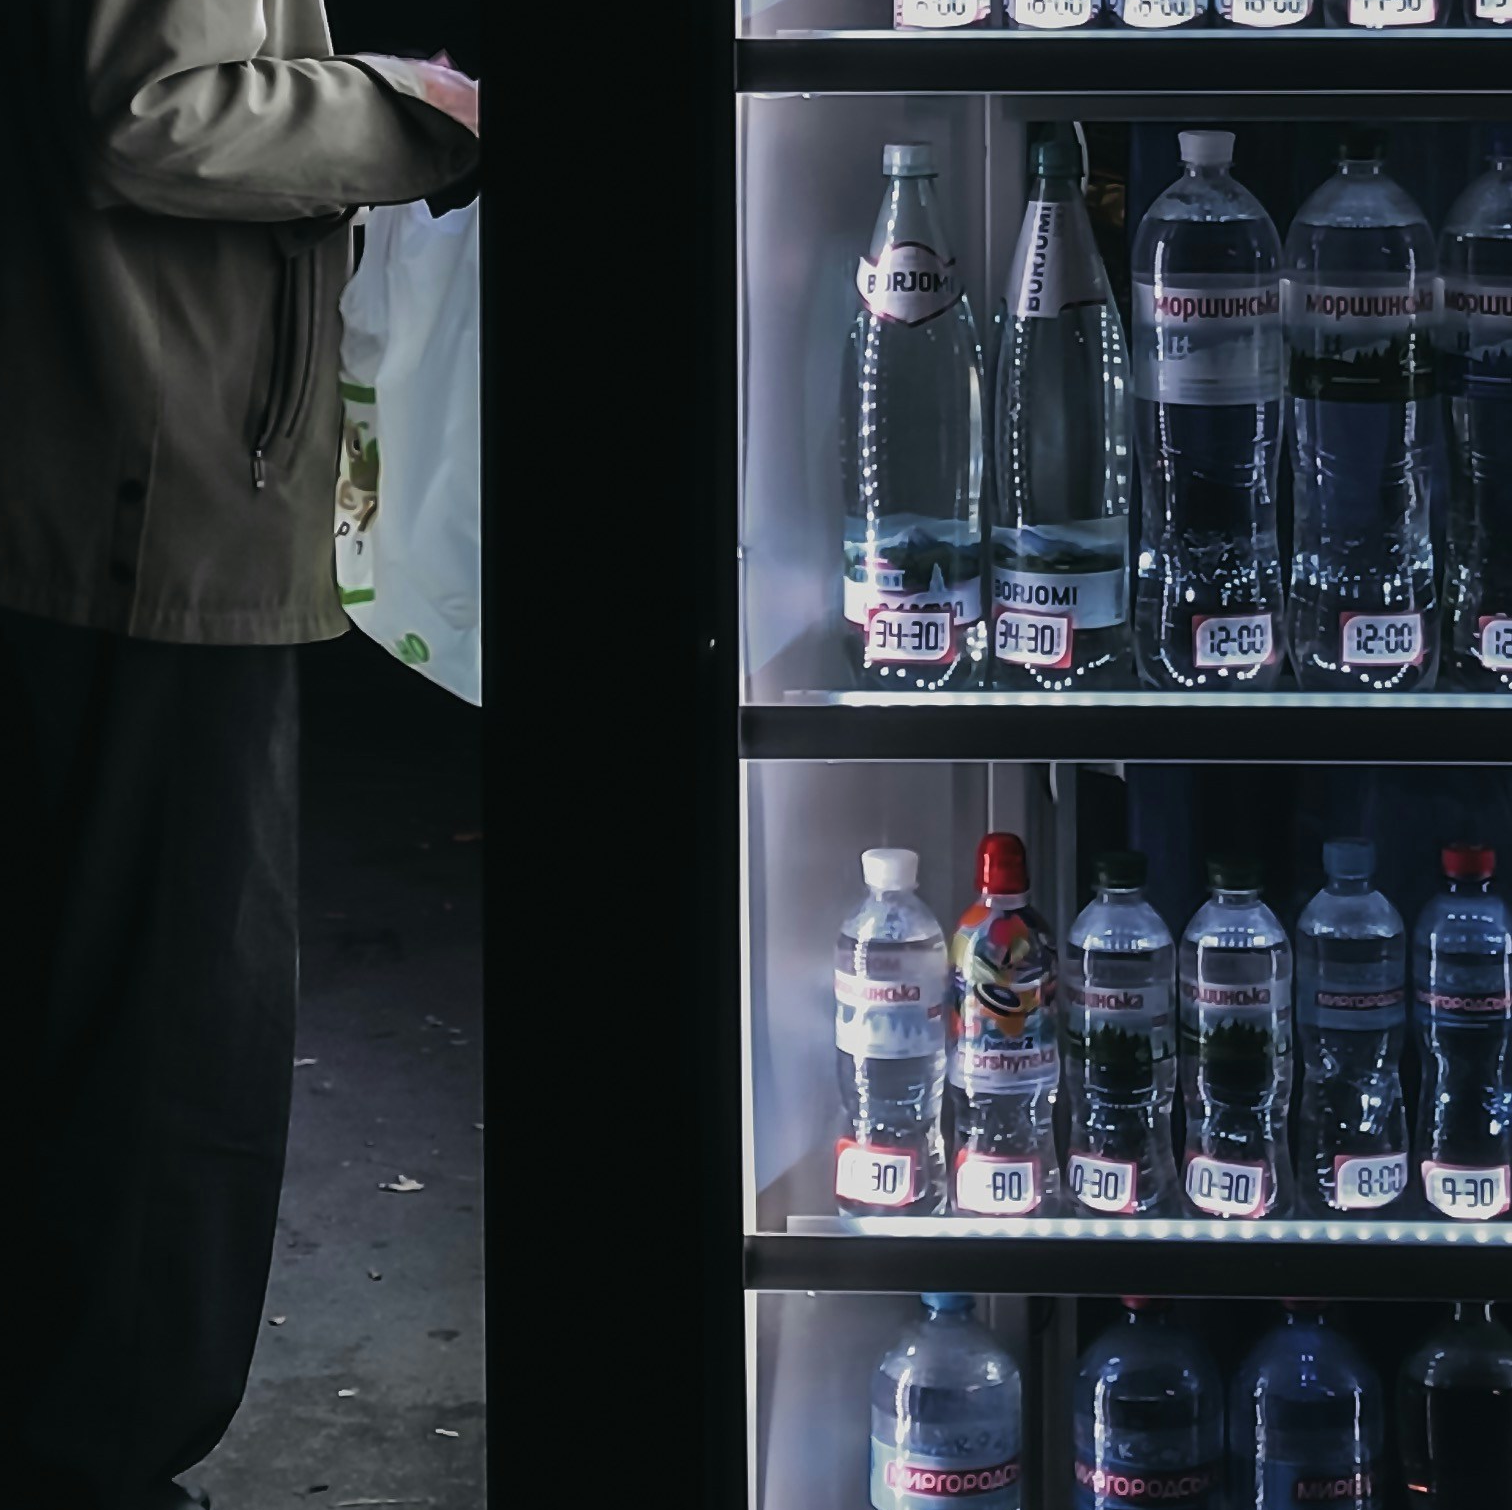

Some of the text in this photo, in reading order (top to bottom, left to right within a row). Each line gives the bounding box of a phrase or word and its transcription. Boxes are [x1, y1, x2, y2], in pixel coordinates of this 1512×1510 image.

[874, 619, 939, 651] 34-30
[998, 618, 1056, 655] 34-30
[1209, 624, 1266, 656] 12-00
[1356, 622, 1413, 654] 12-00
[1442, 1176, 1494, 1208] 9-30
